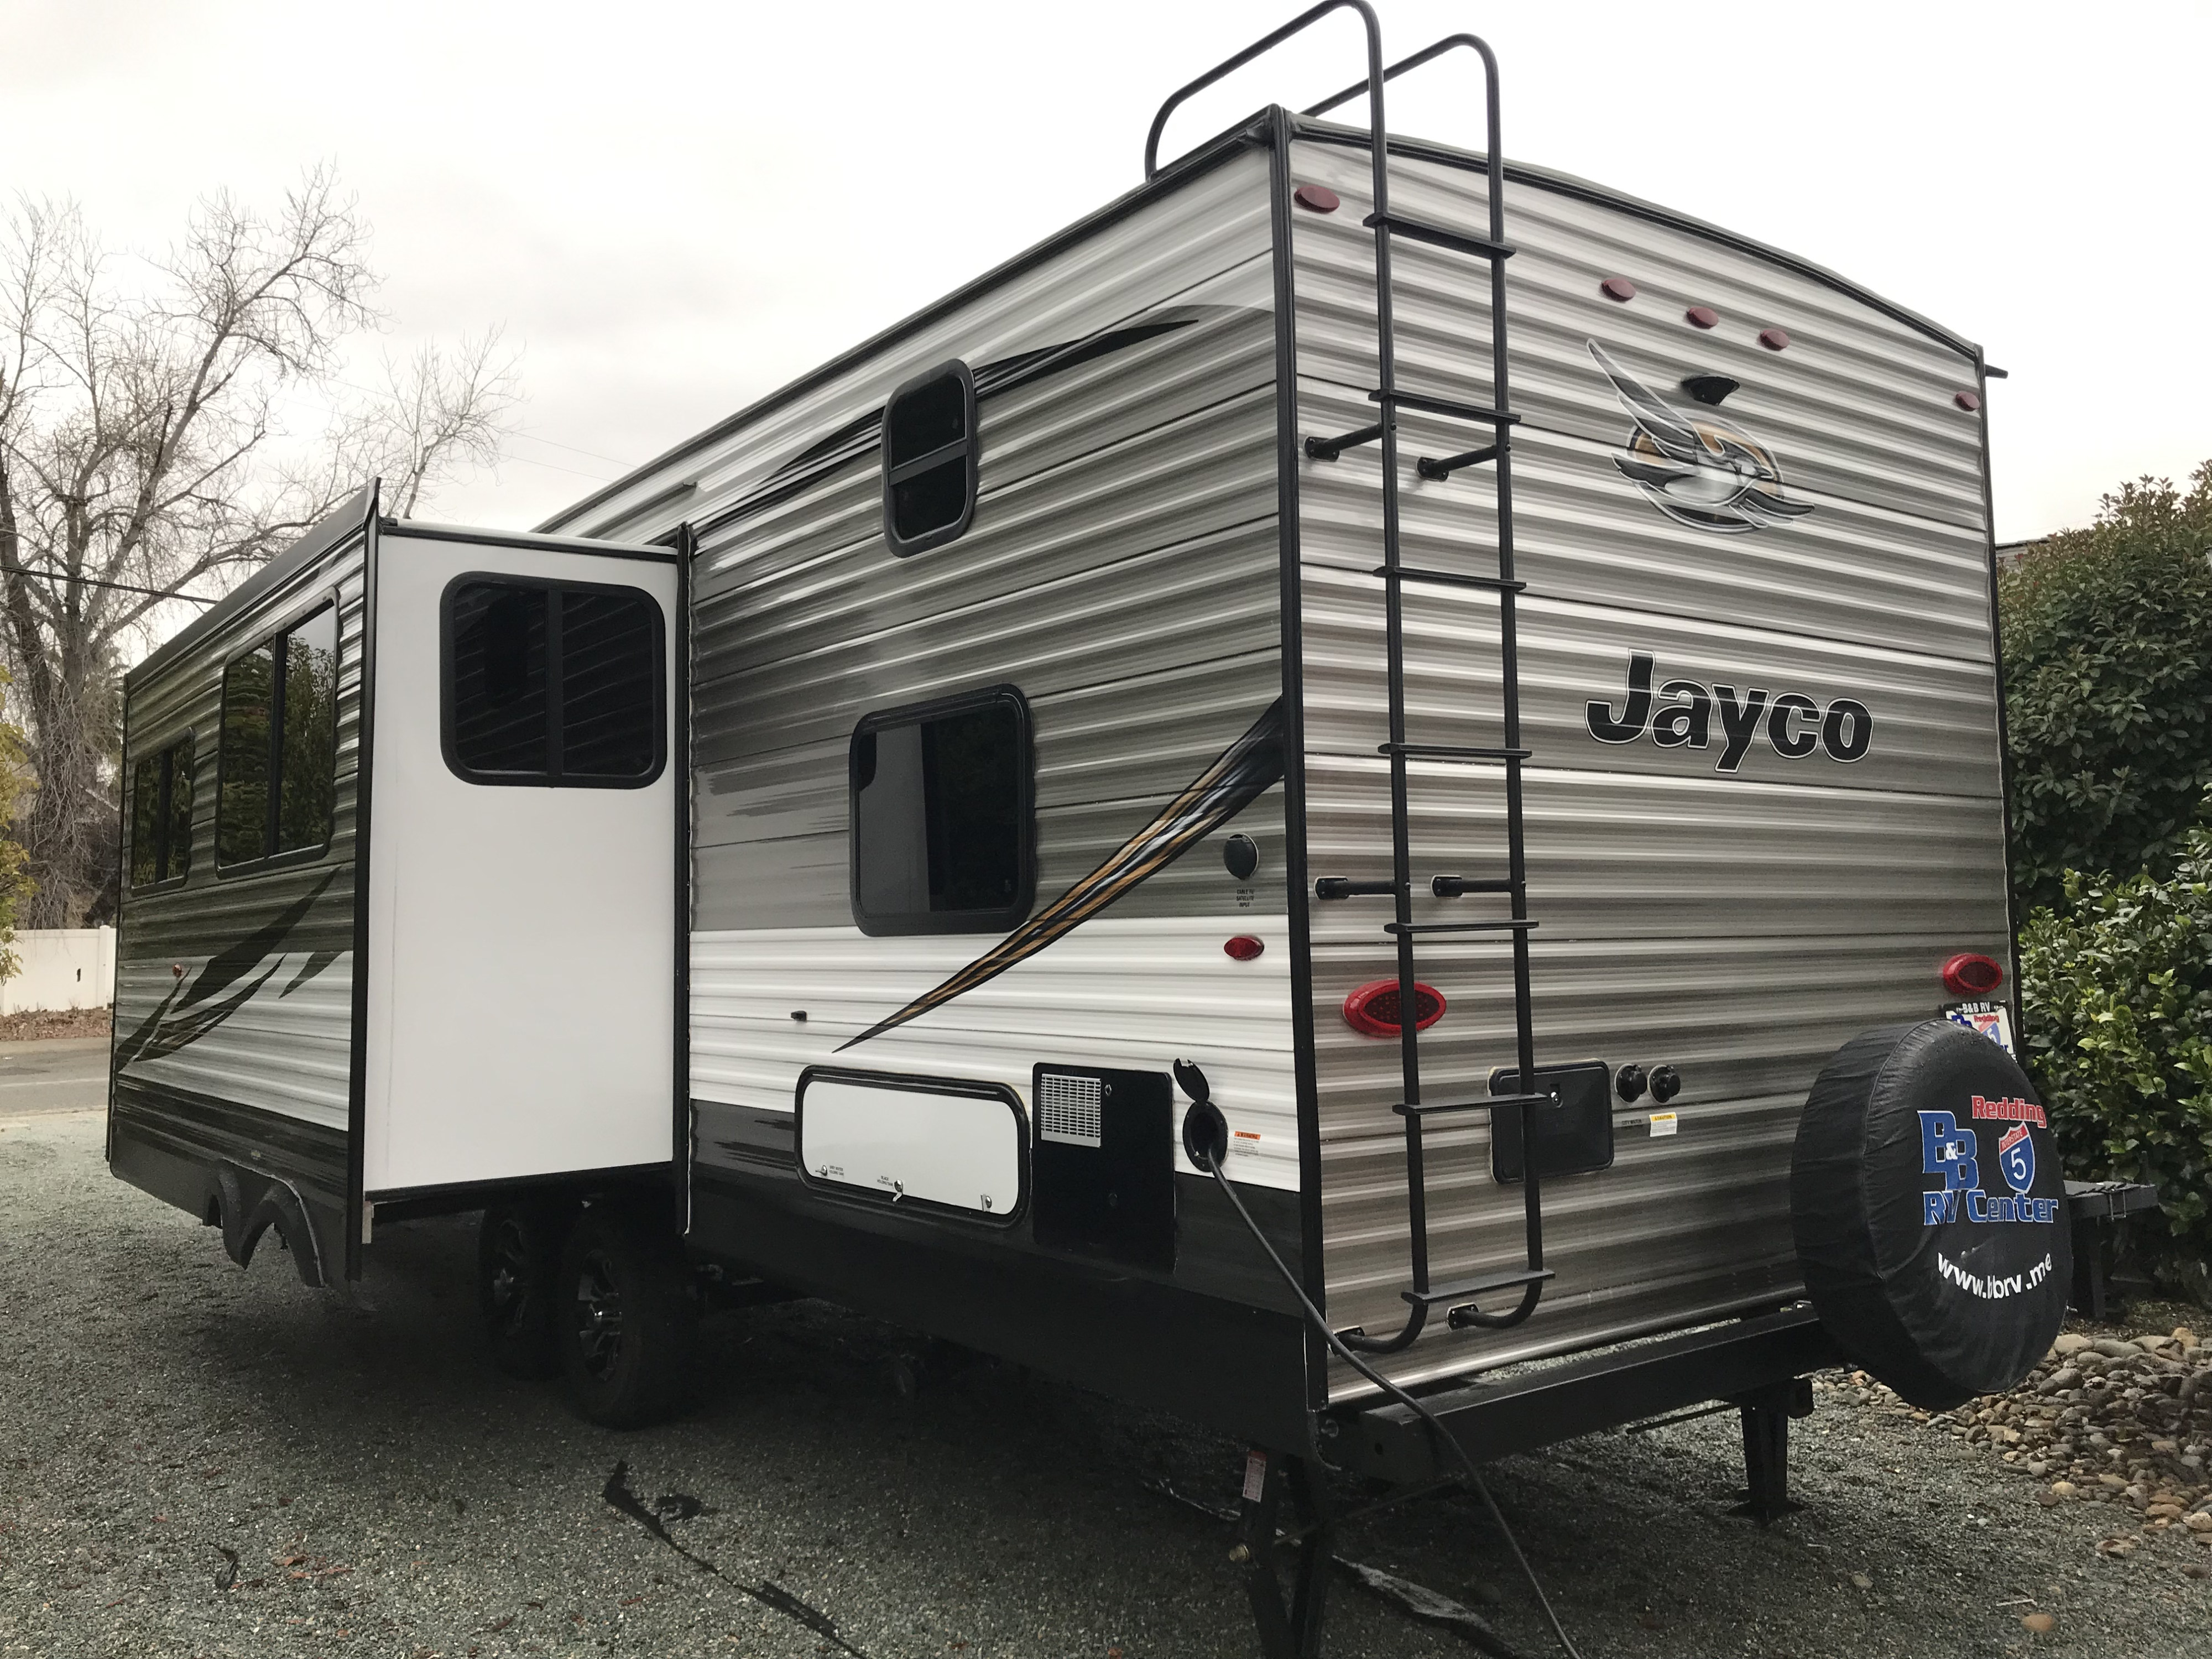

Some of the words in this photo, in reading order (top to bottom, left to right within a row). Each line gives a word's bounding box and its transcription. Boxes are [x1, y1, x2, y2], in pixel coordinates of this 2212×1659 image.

[1585, 648, 1874, 773] Jayco
[1980, 1001, 1990, 1012] RV
[1971, 1095, 2047, 1129] Redding
[2001, 1130, 2023, 1150] INTERSTATE
[2011, 1147, 2027, 1180] 5
[1922, 1190, 1963, 1225] RV
[1966, 1189, 2059, 1223] Center
